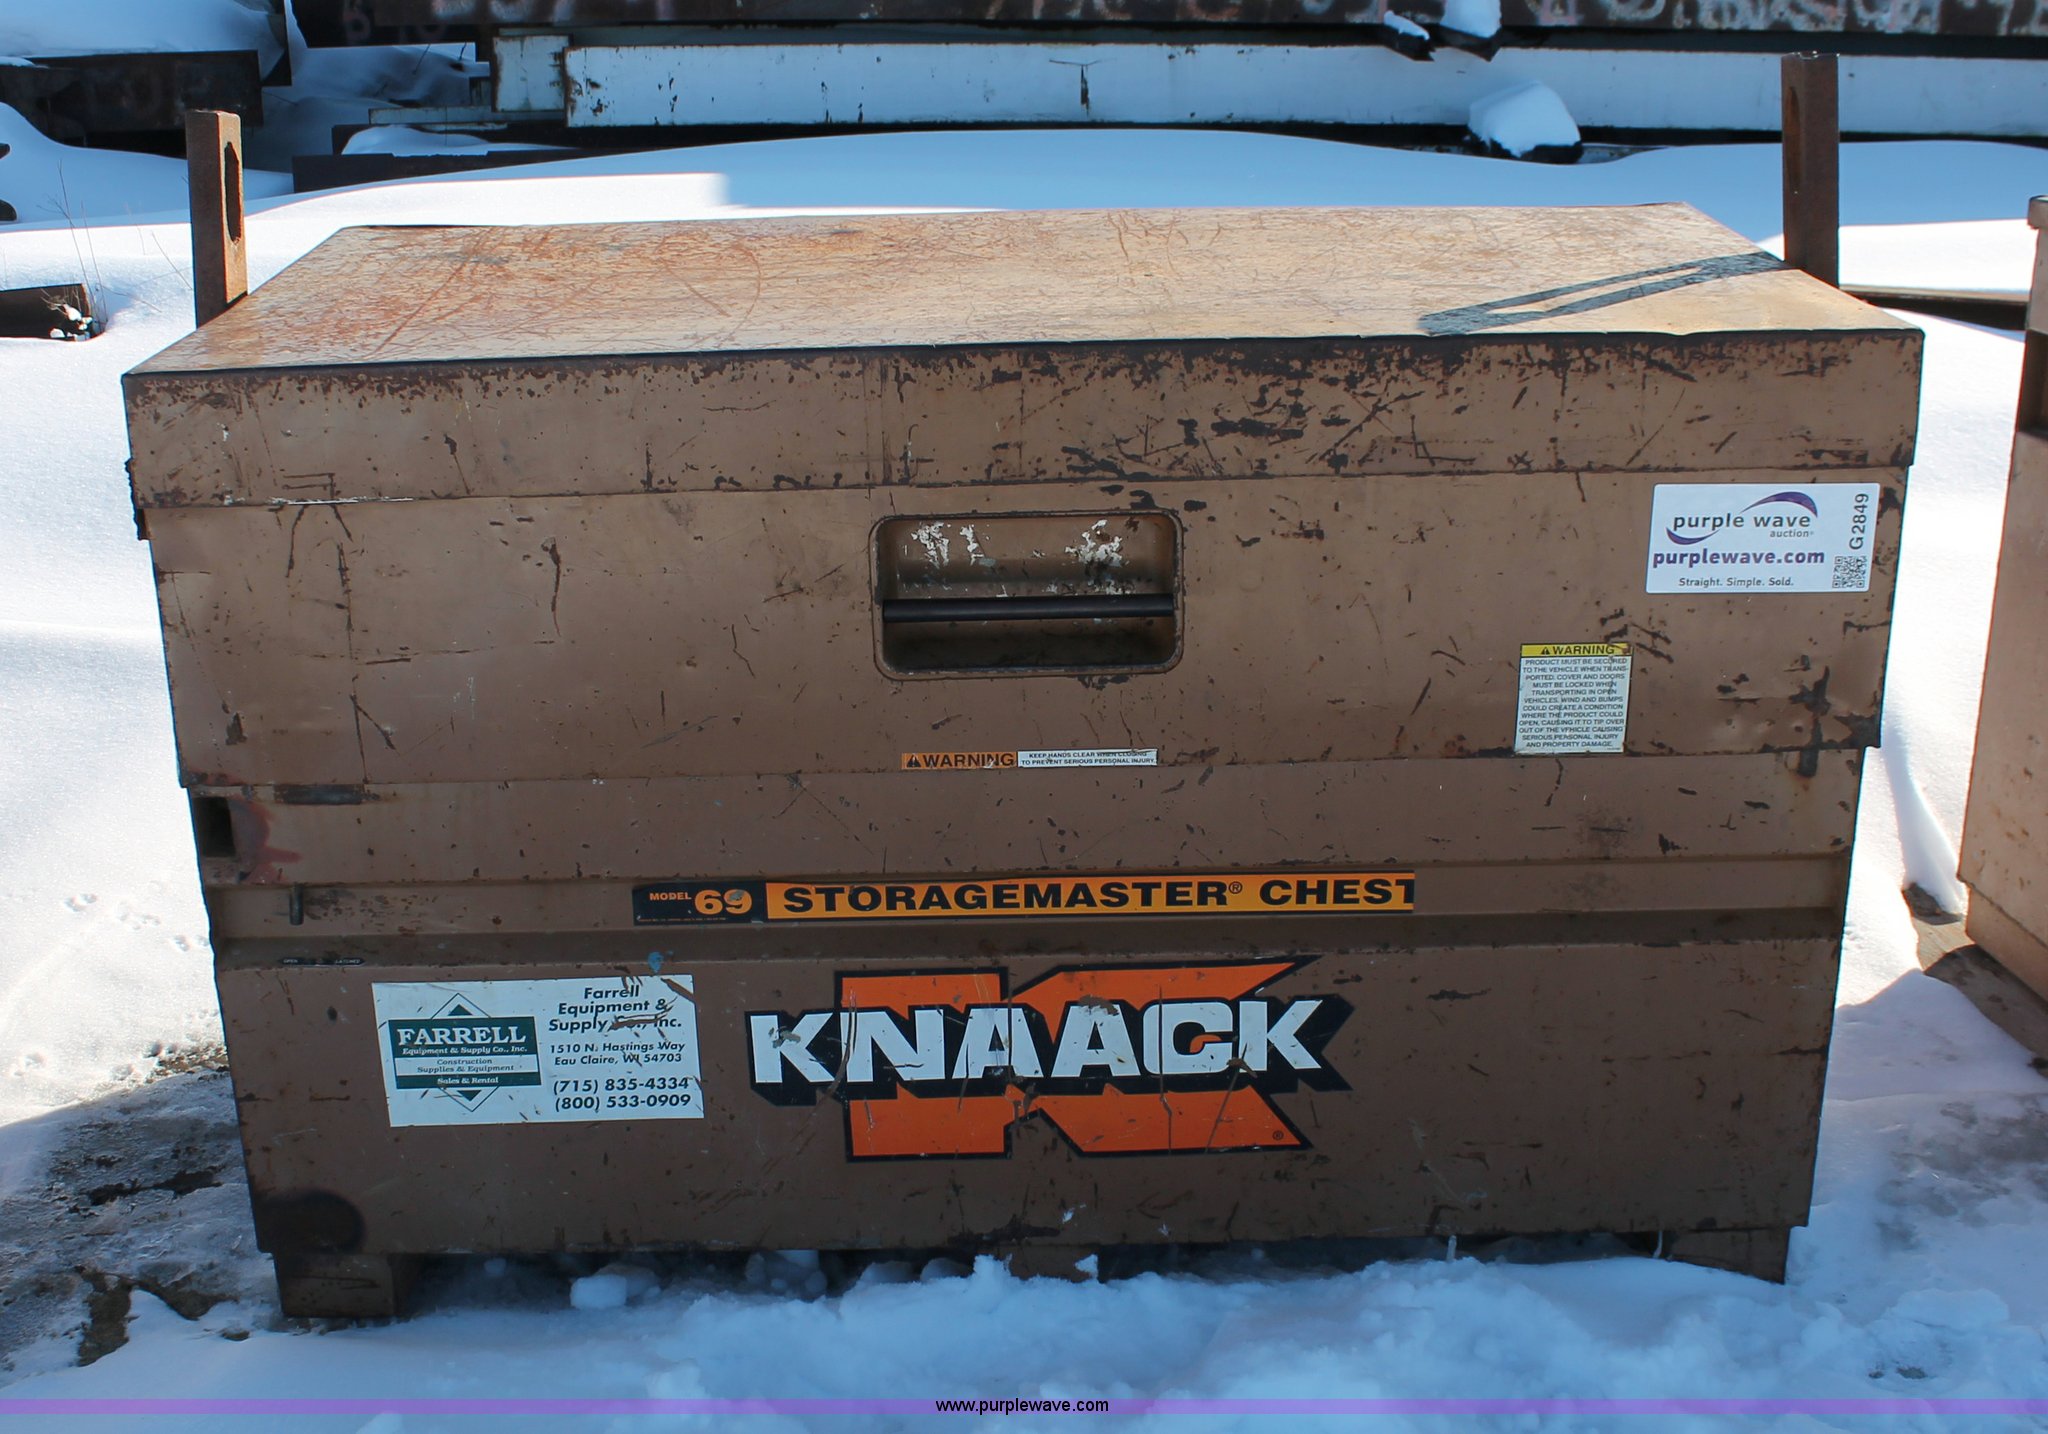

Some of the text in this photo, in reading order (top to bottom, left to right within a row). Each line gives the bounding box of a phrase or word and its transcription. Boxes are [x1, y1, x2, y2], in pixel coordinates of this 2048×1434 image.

[1673, 513, 1811, 531] purple wave
[1849, 493, 1869, 550] G2849
[1770, 530, 1809, 538] auction
[1652, 548, 1825, 568] purplewave.com
[1678, 577, 1794, 588] Straight. Simple. Sold.
[1552, 645, 1615, 655] WARNING
[924, 753, 1015, 768] WARNING
[1259, 879, 1415, 906] CHEST
[650, 889, 752, 915] MODEL 69
[584, 985, 639, 999] Farrell
[558, 999, 667, 1017] Equipment &
[549, 1015, 608, 1034] Supply
[397, 1026, 526, 1046] FARRELL
[750, 1000, 1323, 1084] KNAACK
[402, 1047, 448, 1055] Equipment
[461, 1046, 490, 1054] Supply
[551, 1041, 685, 1054] 1510 N. Hastings Way
[555, 1053, 682, 1065] Eau Claire, WI 54703
[417, 1065, 454, 1073] Supplies
[467, 1065, 514, 1073] Equipment
[437, 1077, 459, 1085] Sales
[553, 1077, 689, 1095] (715) 835-4334
[555, 1094, 691, 1112] (800) 533-0909
